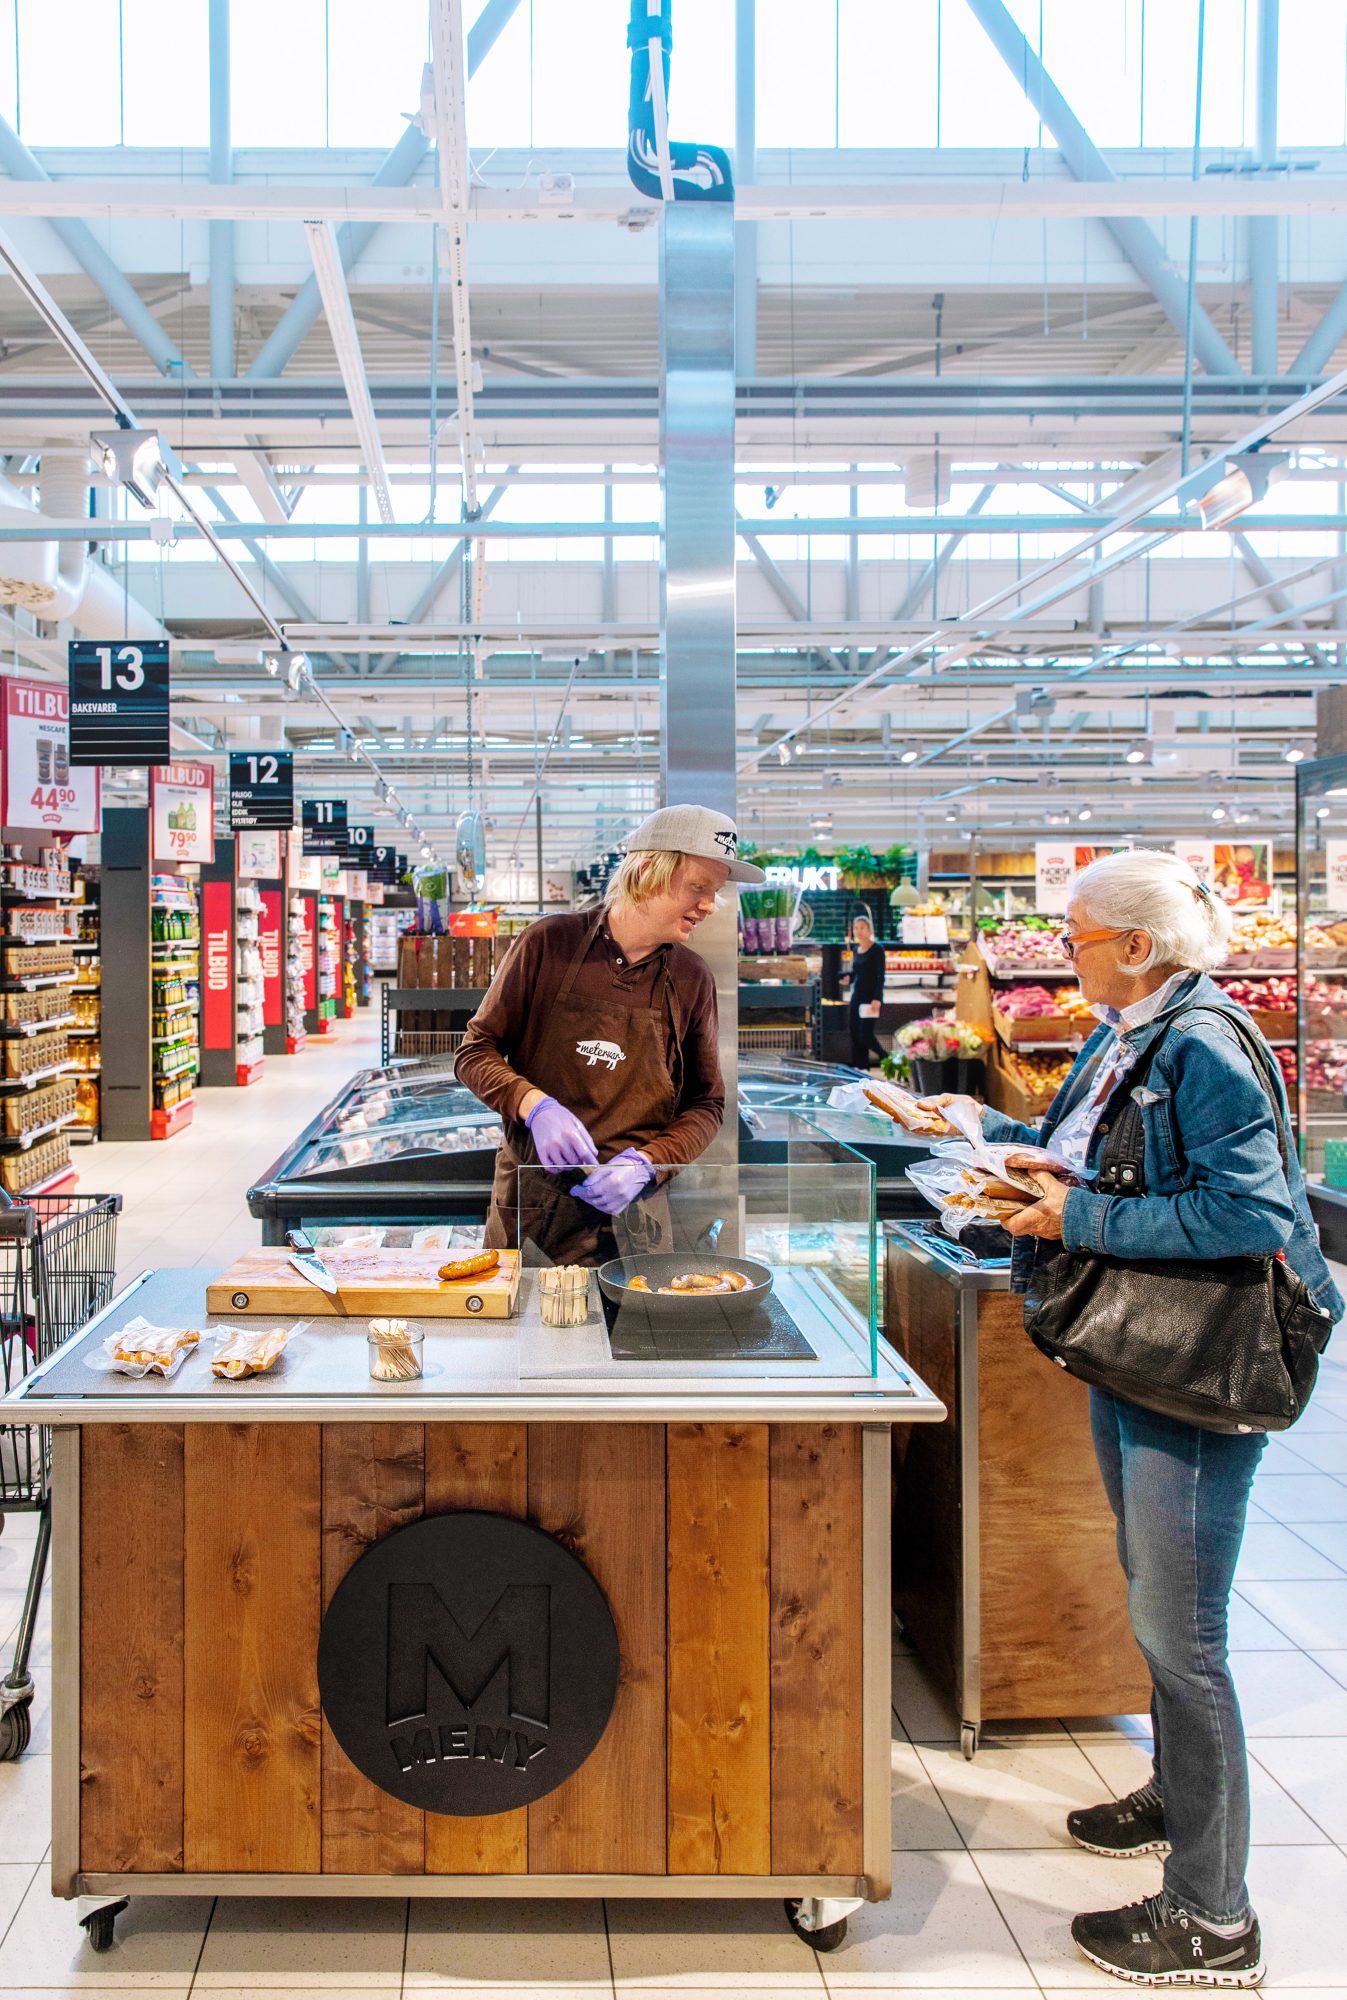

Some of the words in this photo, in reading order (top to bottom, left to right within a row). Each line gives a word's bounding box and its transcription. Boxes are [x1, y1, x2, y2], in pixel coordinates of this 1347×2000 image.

[95, 646, 145, 691] 13
[71, 702, 117, 713] BAKEVARER
[160, 766, 205, 786] TILBUD
[246, 755, 279, 784] 12
[315, 802, 333, 823] 11
[347, 828, 367, 845] 10
[376, 847, 387, 862] 9
[598, 865, 606, 876] 2
[208, 929, 228, 990] TILBUD
[262, 929, 279, 978] TILBUD
[389, 1723, 549, 1772] MENY
